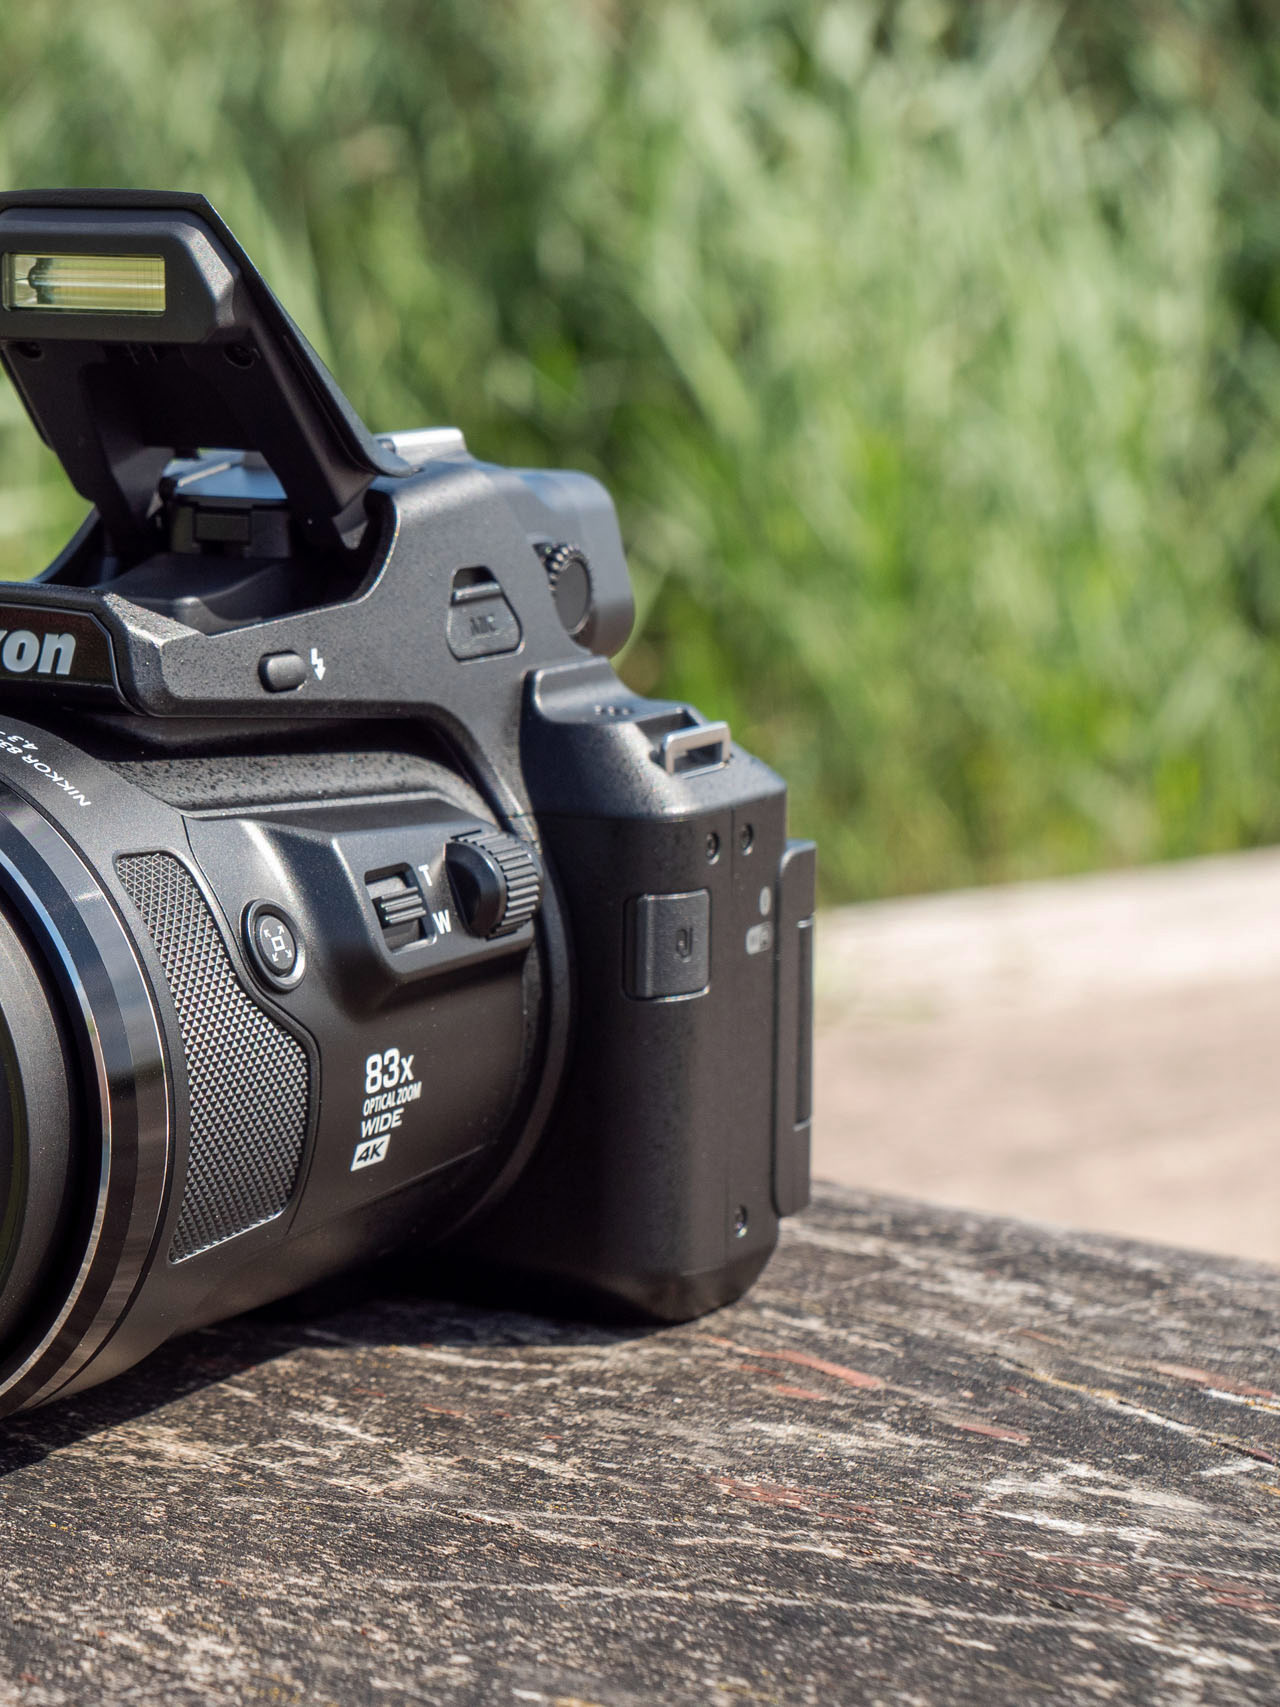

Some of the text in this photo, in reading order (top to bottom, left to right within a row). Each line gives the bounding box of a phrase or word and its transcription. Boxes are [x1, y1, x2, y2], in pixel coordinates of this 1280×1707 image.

[7, 735, 38, 750] 4.3
[22, 754, 91, 806] NIKKOR
[418, 864, 432, 887] T
[432, 909, 451, 934] W
[365, 1048, 414, 1094] 83x
[363, 1081, 422, 1116] OPTICAL ZOOM
[361, 1107, 404, 1138] WIDE
[357, 1141, 384, 1162] 4K
